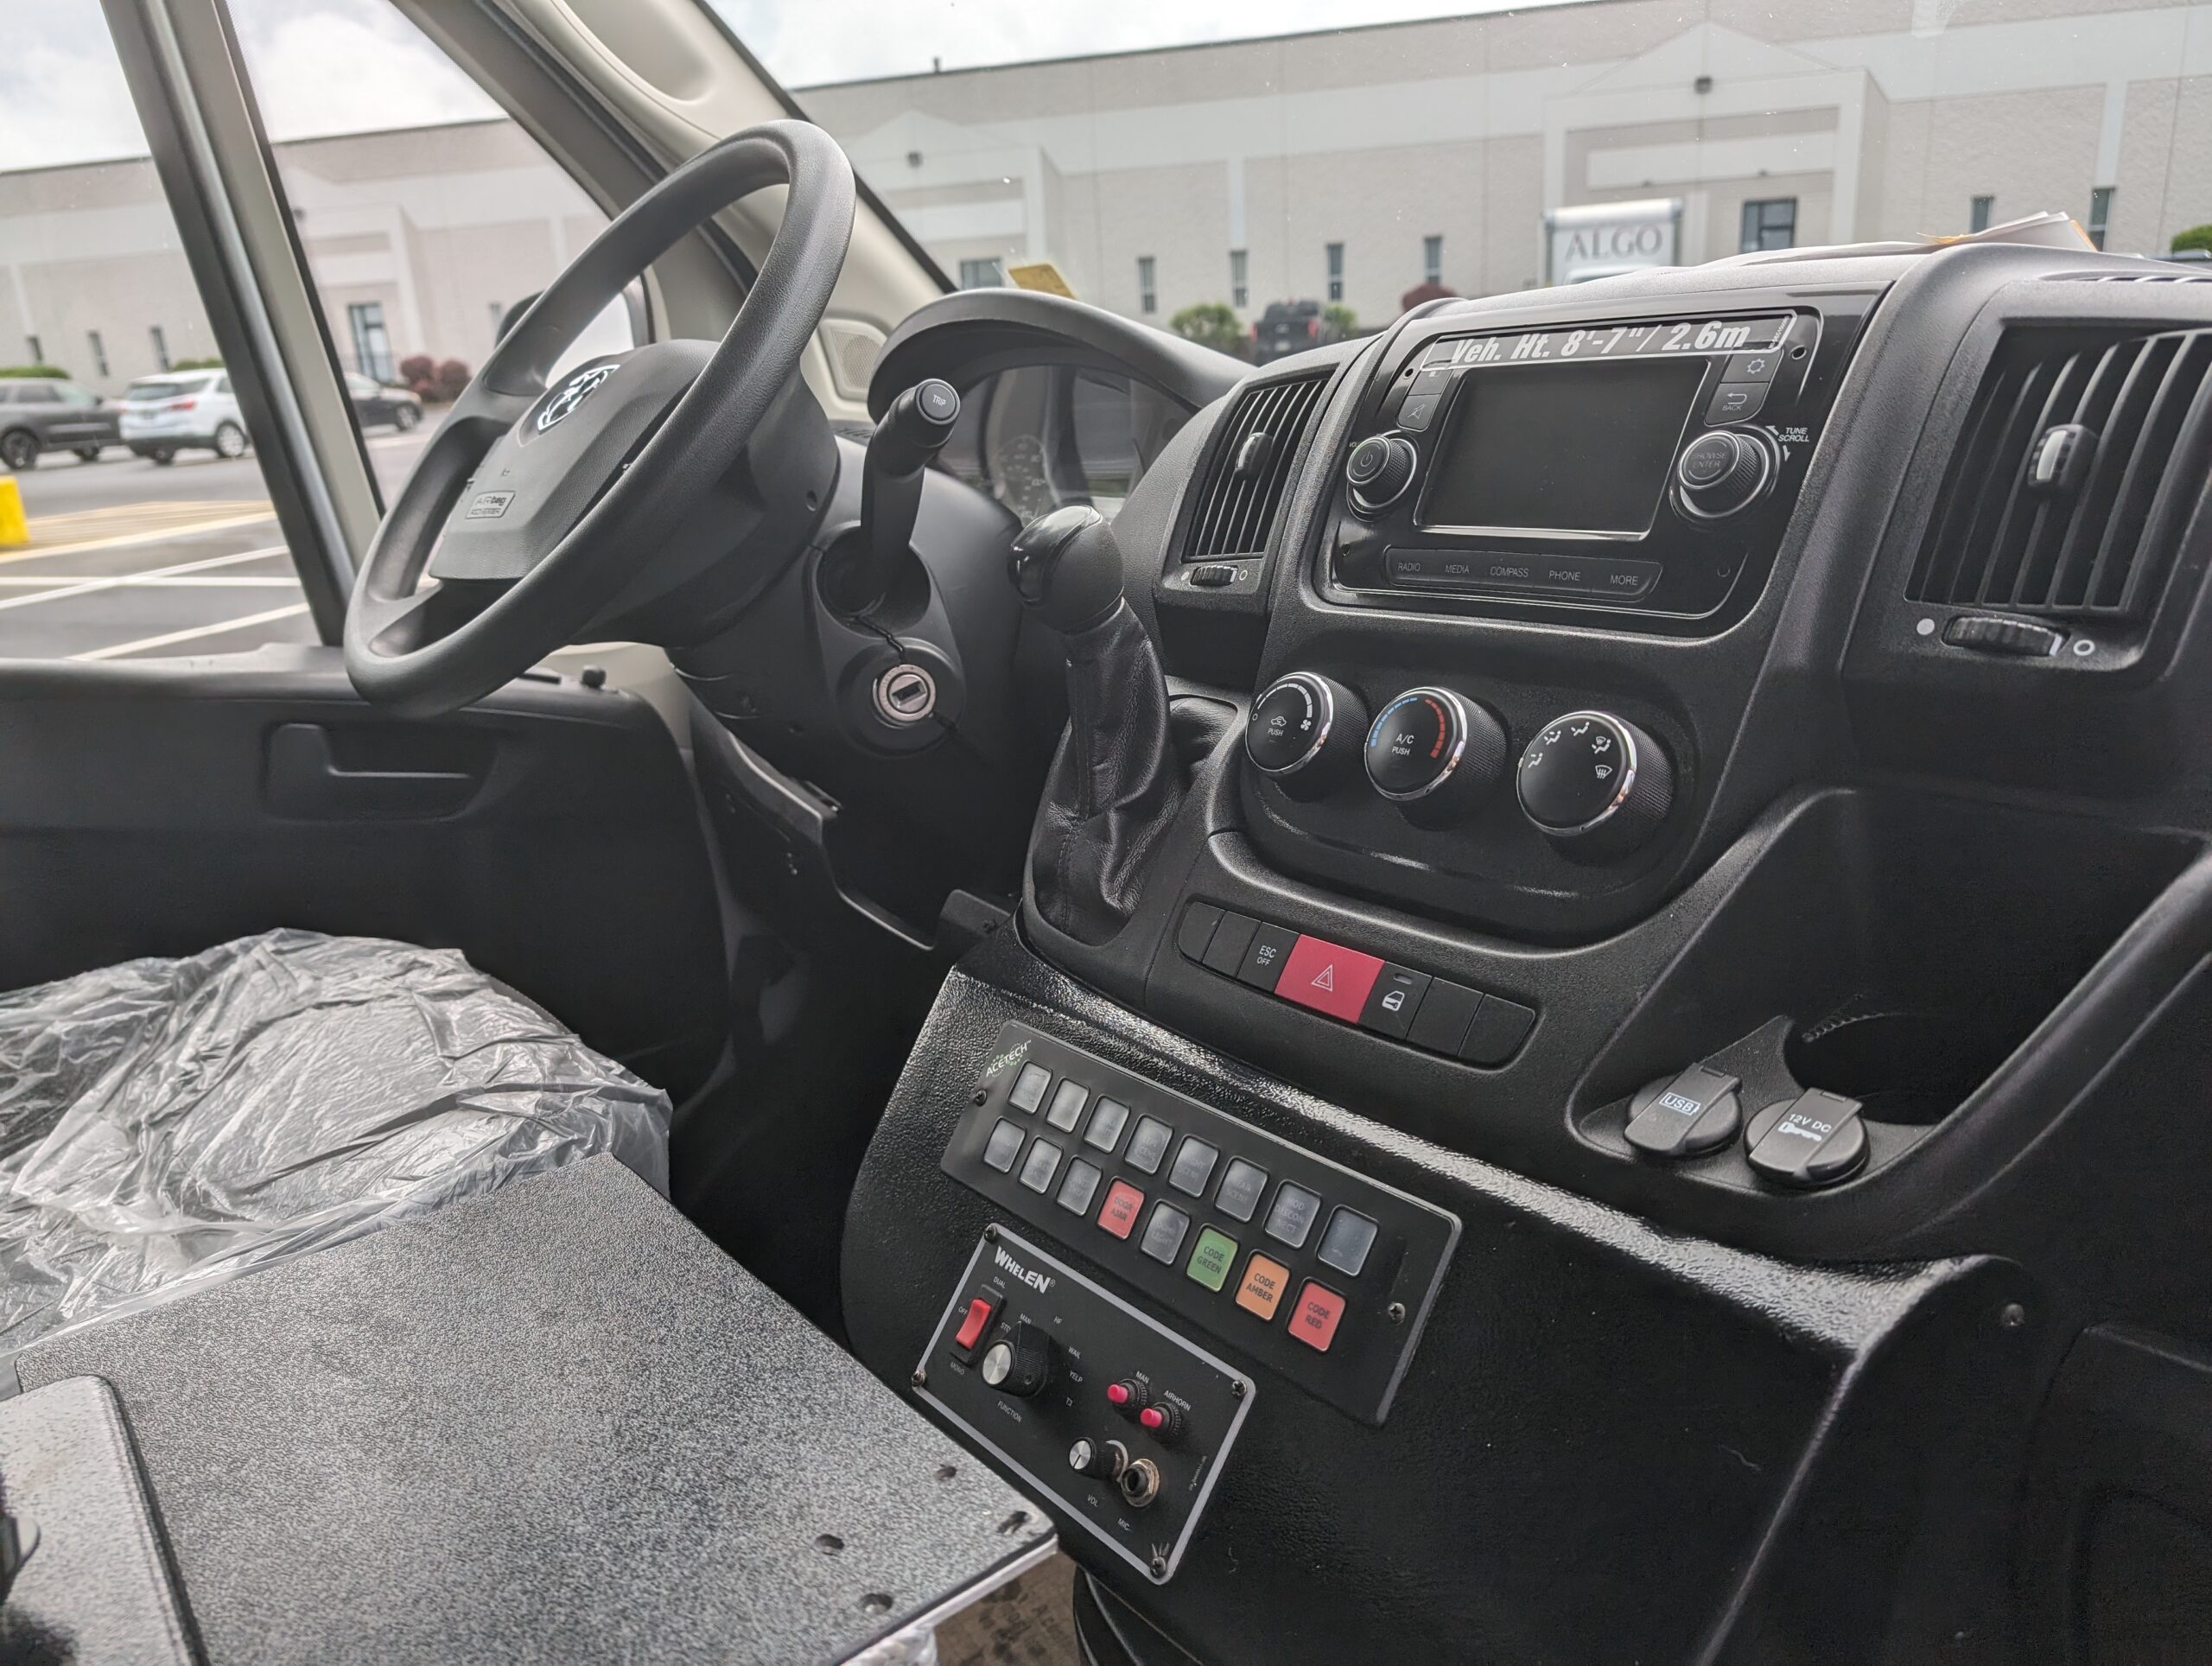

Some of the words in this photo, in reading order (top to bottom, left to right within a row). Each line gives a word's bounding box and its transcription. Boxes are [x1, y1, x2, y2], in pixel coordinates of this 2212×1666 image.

[1565, 224, 1662, 261] ALGO
[1451, 338, 1502, 364] Veh.
[1510, 334, 1551, 360] Ht.
[1662, 321, 1751, 351] 2.6m
[933, 394, 946, 406] TRIP
[1397, 562, 1421, 572] RADIO
[1445, 564, 1470, 574] MEDIA
[1490, 566, 1529, 577] COMPASS
[1548, 570, 1581, 582] PHONE
[1610, 575, 1638, 586] MORE
[1268, 728, 1284, 736] PUSH
[1395, 734, 1414, 744] A/C
[1392, 747, 1410, 755] PUSH
[1259, 945, 1277, 958] ESC
[1256, 957, 1271, 966] OFF
[1664, 1095, 1694, 1111] USB
[1788, 1113, 1809, 1128] 12V
[1812, 1120, 1832, 1133] DC
[1204, 1245, 1224, 1262] CODE
[1197, 1256, 1222, 1275] GREEN
[993, 1276, 1006, 1289] DUAL
[1254, 1272, 1276, 1290] CODE
[1246, 1282, 1274, 1303] AMBER
[958, 1306, 969, 1315] OFF
[1306, 1302, 1331, 1319] CODE
[1020, 1313, 1032, 1325] MAN
[1054, 1316, 1063, 1325] HF
[1305, 1314, 1323, 1330] RED
[1069, 1345, 1081, 1358] WAIL
[1070, 1370, 1083, 1383] YELP
[1136, 1370, 1150, 1384] MAN
[1164, 1390, 1191, 1411] AIRHORN
[998, 1401, 1022, 1423] FUNCTION
[1087, 1494, 1099, 1507] VOL
[1118, 1517, 1130, 1531] MIC
